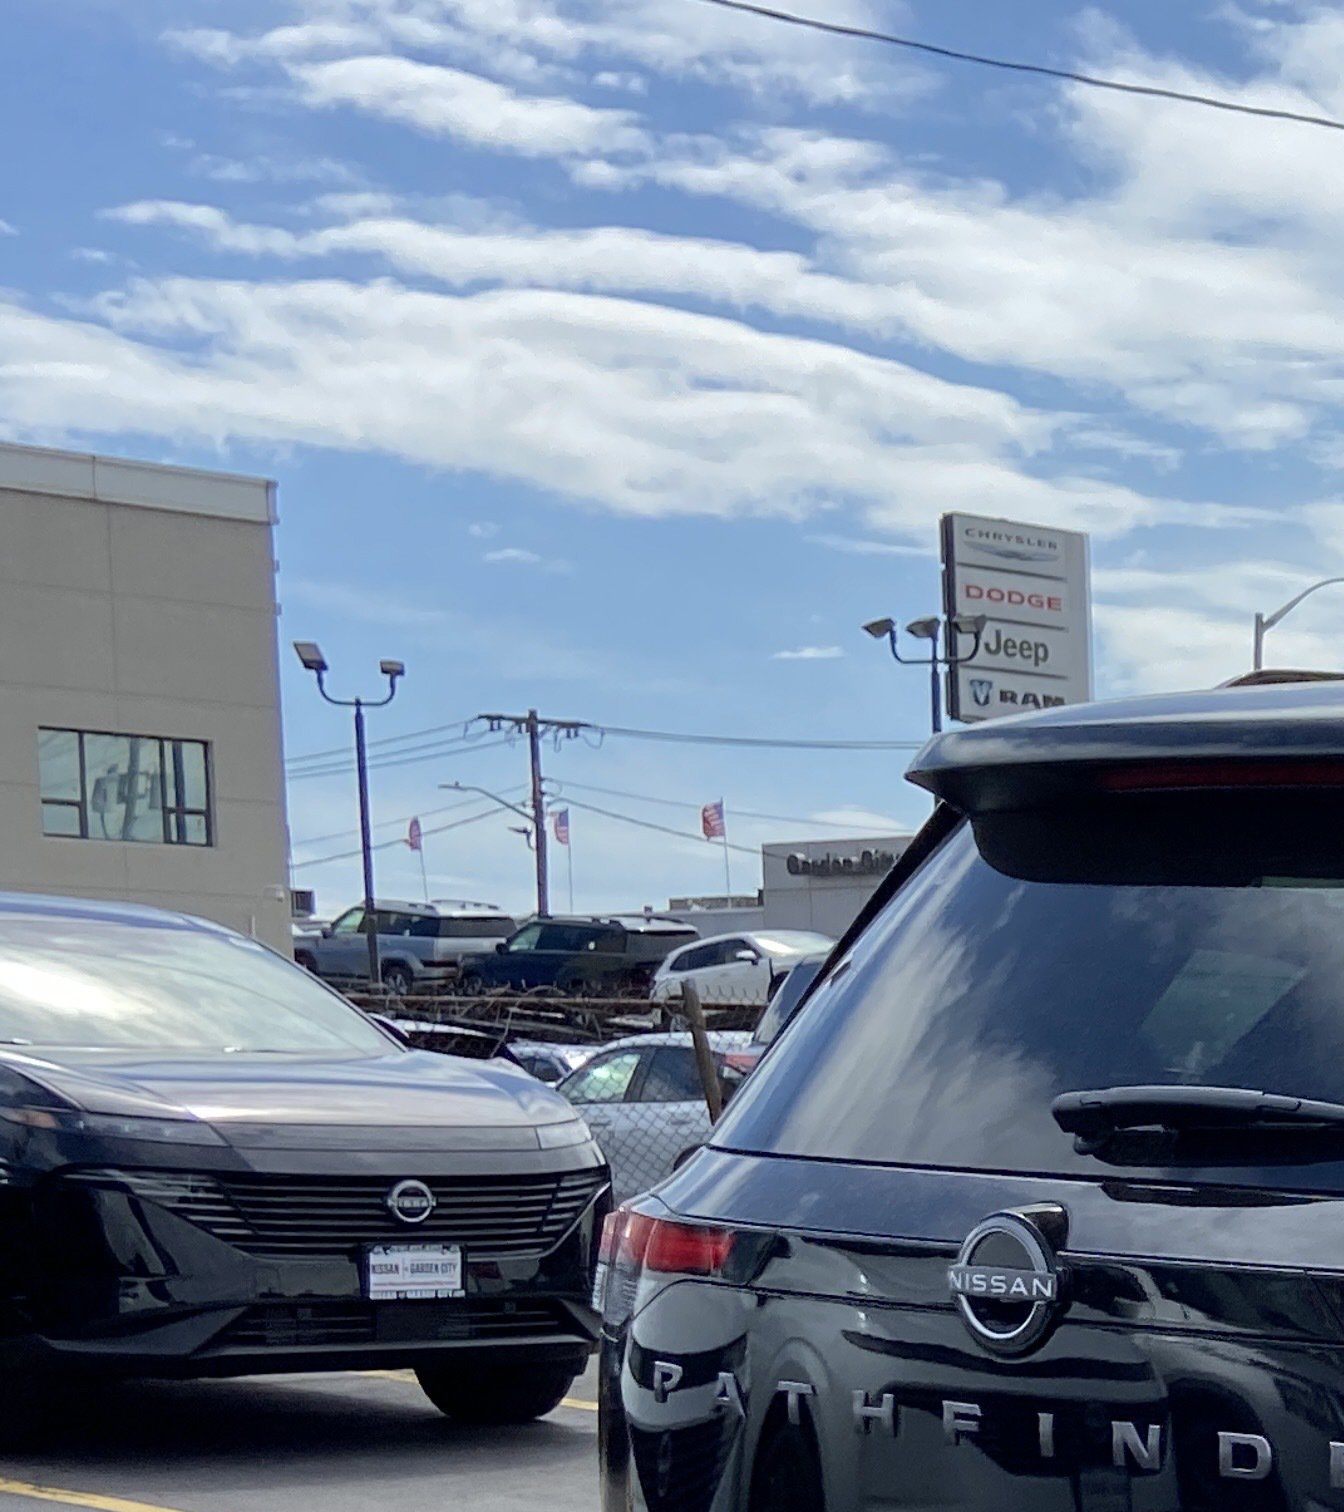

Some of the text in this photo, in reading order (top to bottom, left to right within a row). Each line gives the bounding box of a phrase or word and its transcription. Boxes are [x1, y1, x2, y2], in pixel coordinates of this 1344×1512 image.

[965, 527, 1058, 550] CHRYSLER
[964, 584, 1063, 611] DODGE
[984, 629, 1049, 667] Jeep
[999, 689, 1065, 709] RAM
[948, 1270, 1053, 1297] NISSAN
